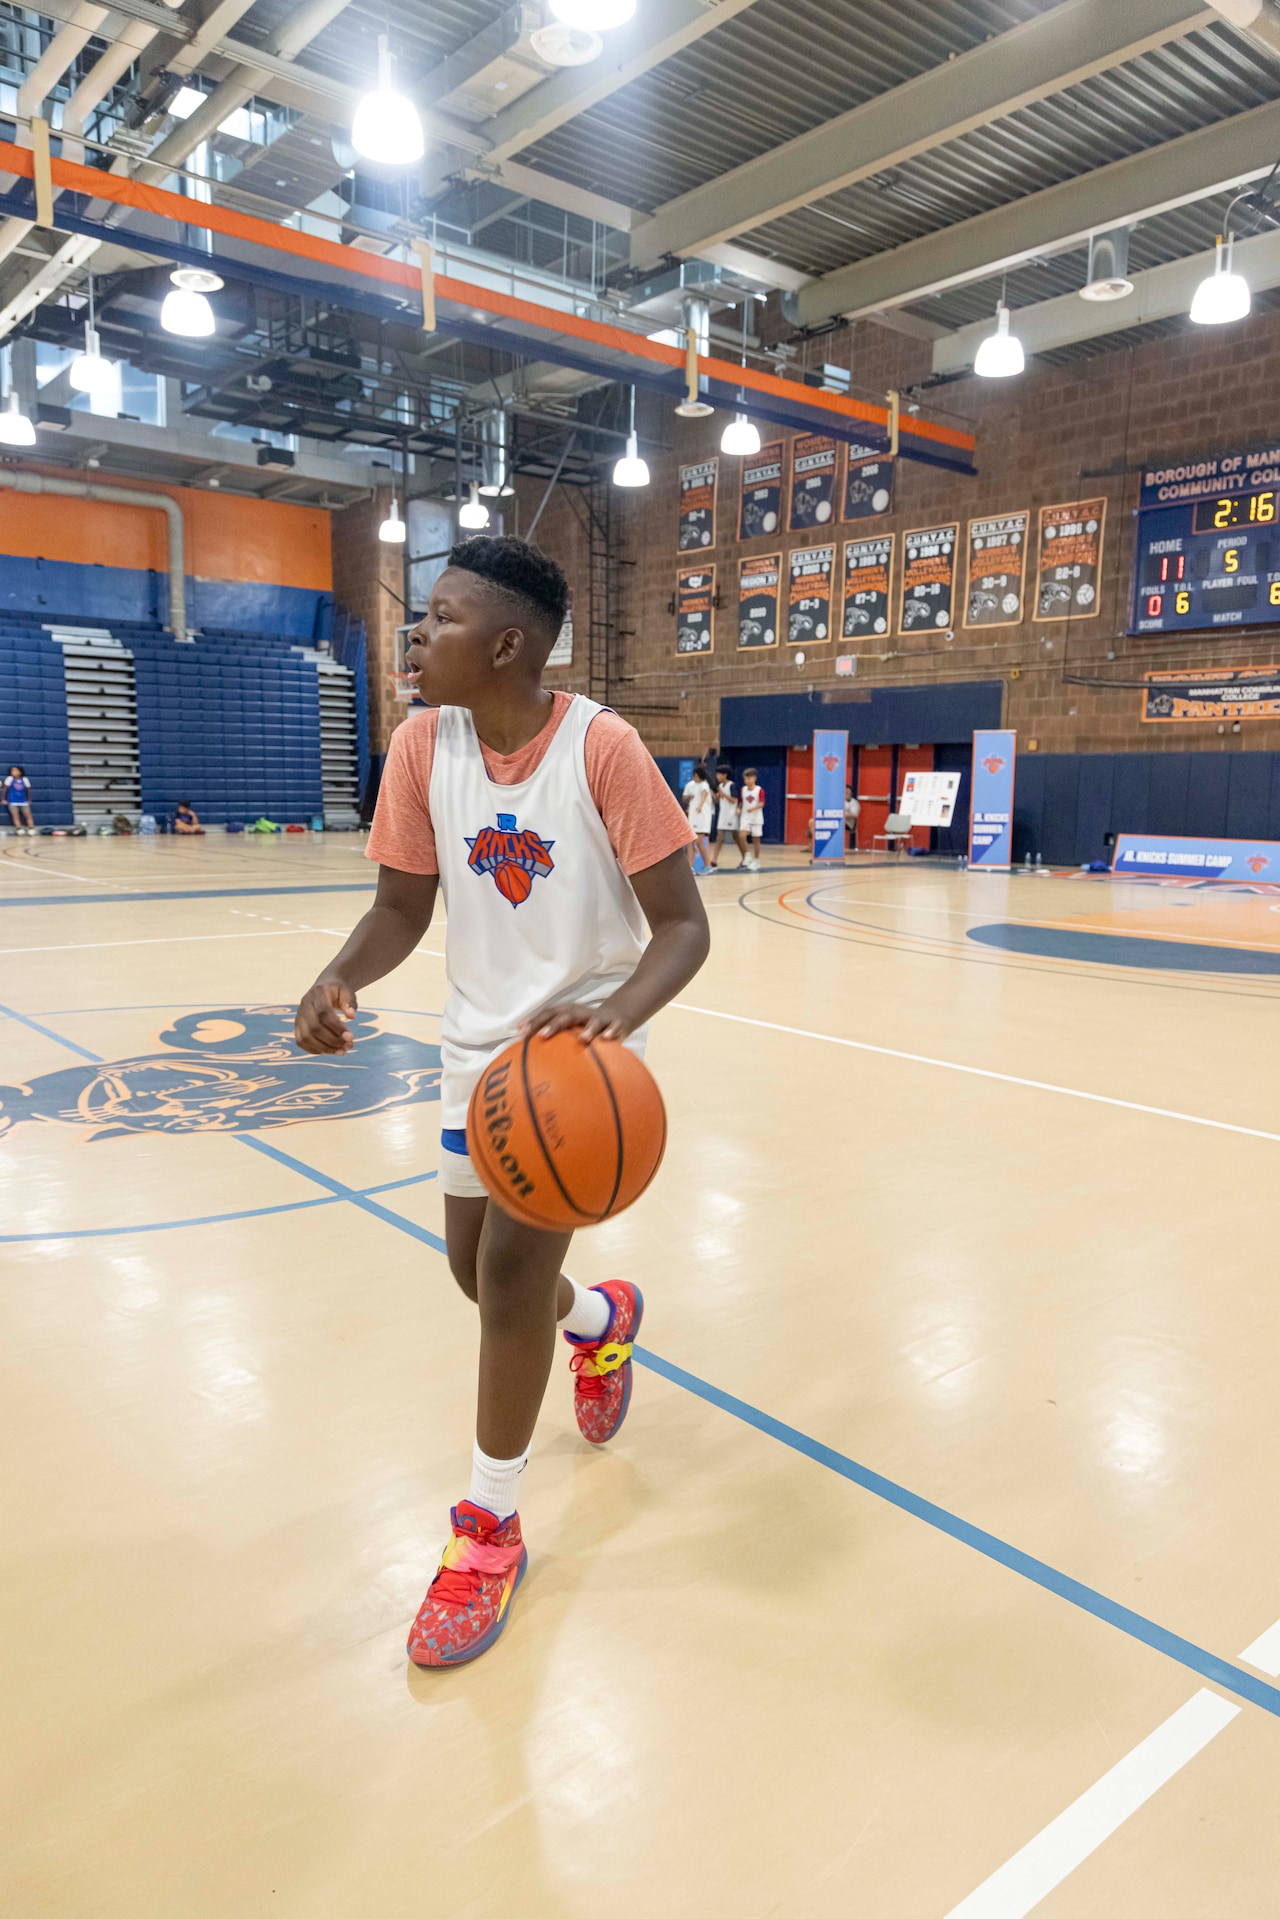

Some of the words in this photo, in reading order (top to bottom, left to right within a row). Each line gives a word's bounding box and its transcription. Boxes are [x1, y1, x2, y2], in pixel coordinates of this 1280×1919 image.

[1145, 461, 1217, 486] BOROUGH
[1221, 456, 1242, 473] OF
[1158, 472, 1248, 500] COMMUNITY
[1214, 492, 1274, 528] 2:16
[1150, 538, 1183, 554] HOME
[1217, 536, 1248, 549] PERIOD
[1161, 555, 1184, 581] 11
[1224, 549, 1239, 573] 5
[1140, 585, 1166, 596] FOULS
[1202, 577, 1234, 589] PLAYER
[1236, 575, 1259, 587] FOUL
[1148, 595, 1162, 617] 0
[1175, 592, 1190, 615] 6
[1213, 611, 1242, 623] MATCH
[467, 826, 555, 872] KNCKS
[1136, 851, 1167, 864] KNICKS
[1167, 853, 1205, 866] SUMMER
[1205, 855, 1233, 868] CAMP
[484, 1060, 535, 1198] Wilson
